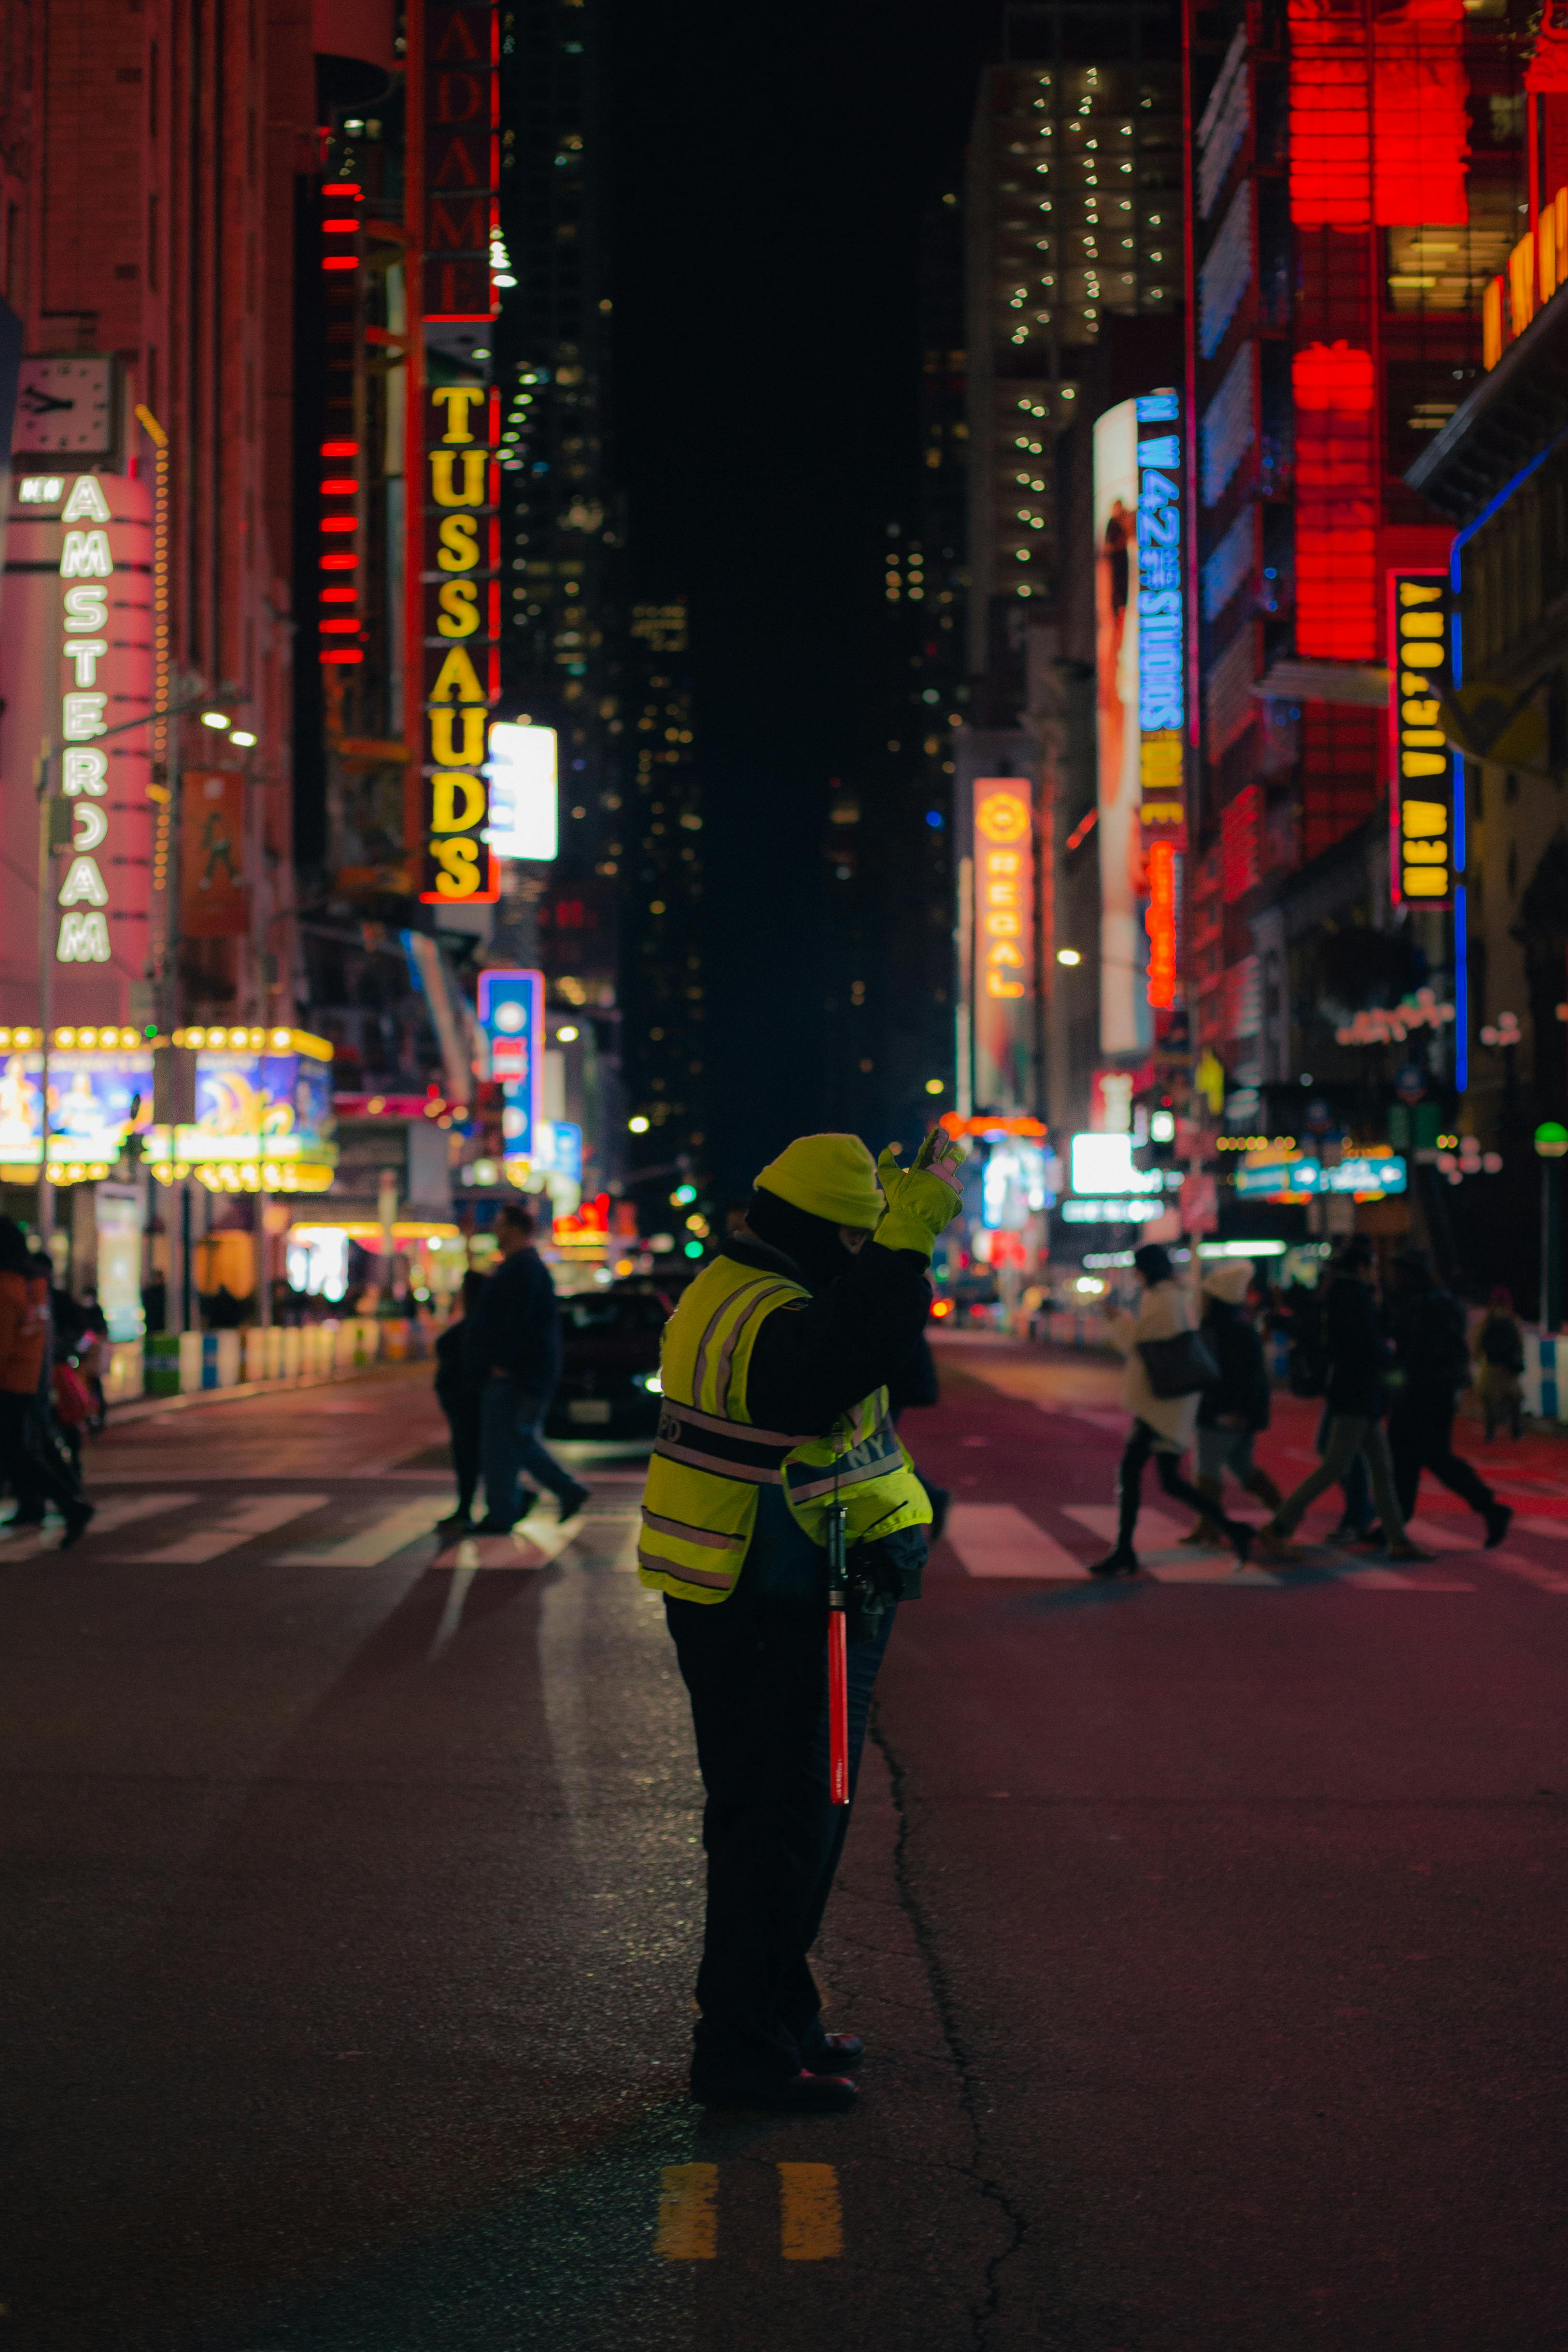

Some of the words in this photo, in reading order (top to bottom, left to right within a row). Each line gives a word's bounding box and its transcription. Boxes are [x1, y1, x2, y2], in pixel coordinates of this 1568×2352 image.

[56, 475, 113, 962] AMSTERDAM
[427, 387, 490, 898] TUSSAUDS
[1138, 589, 1184, 731] STUDIOS
[1399, 581, 1447, 778] VICTORY
[1402, 799, 1448, 897] NEW
[847, 1432, 887, 1469] NY
